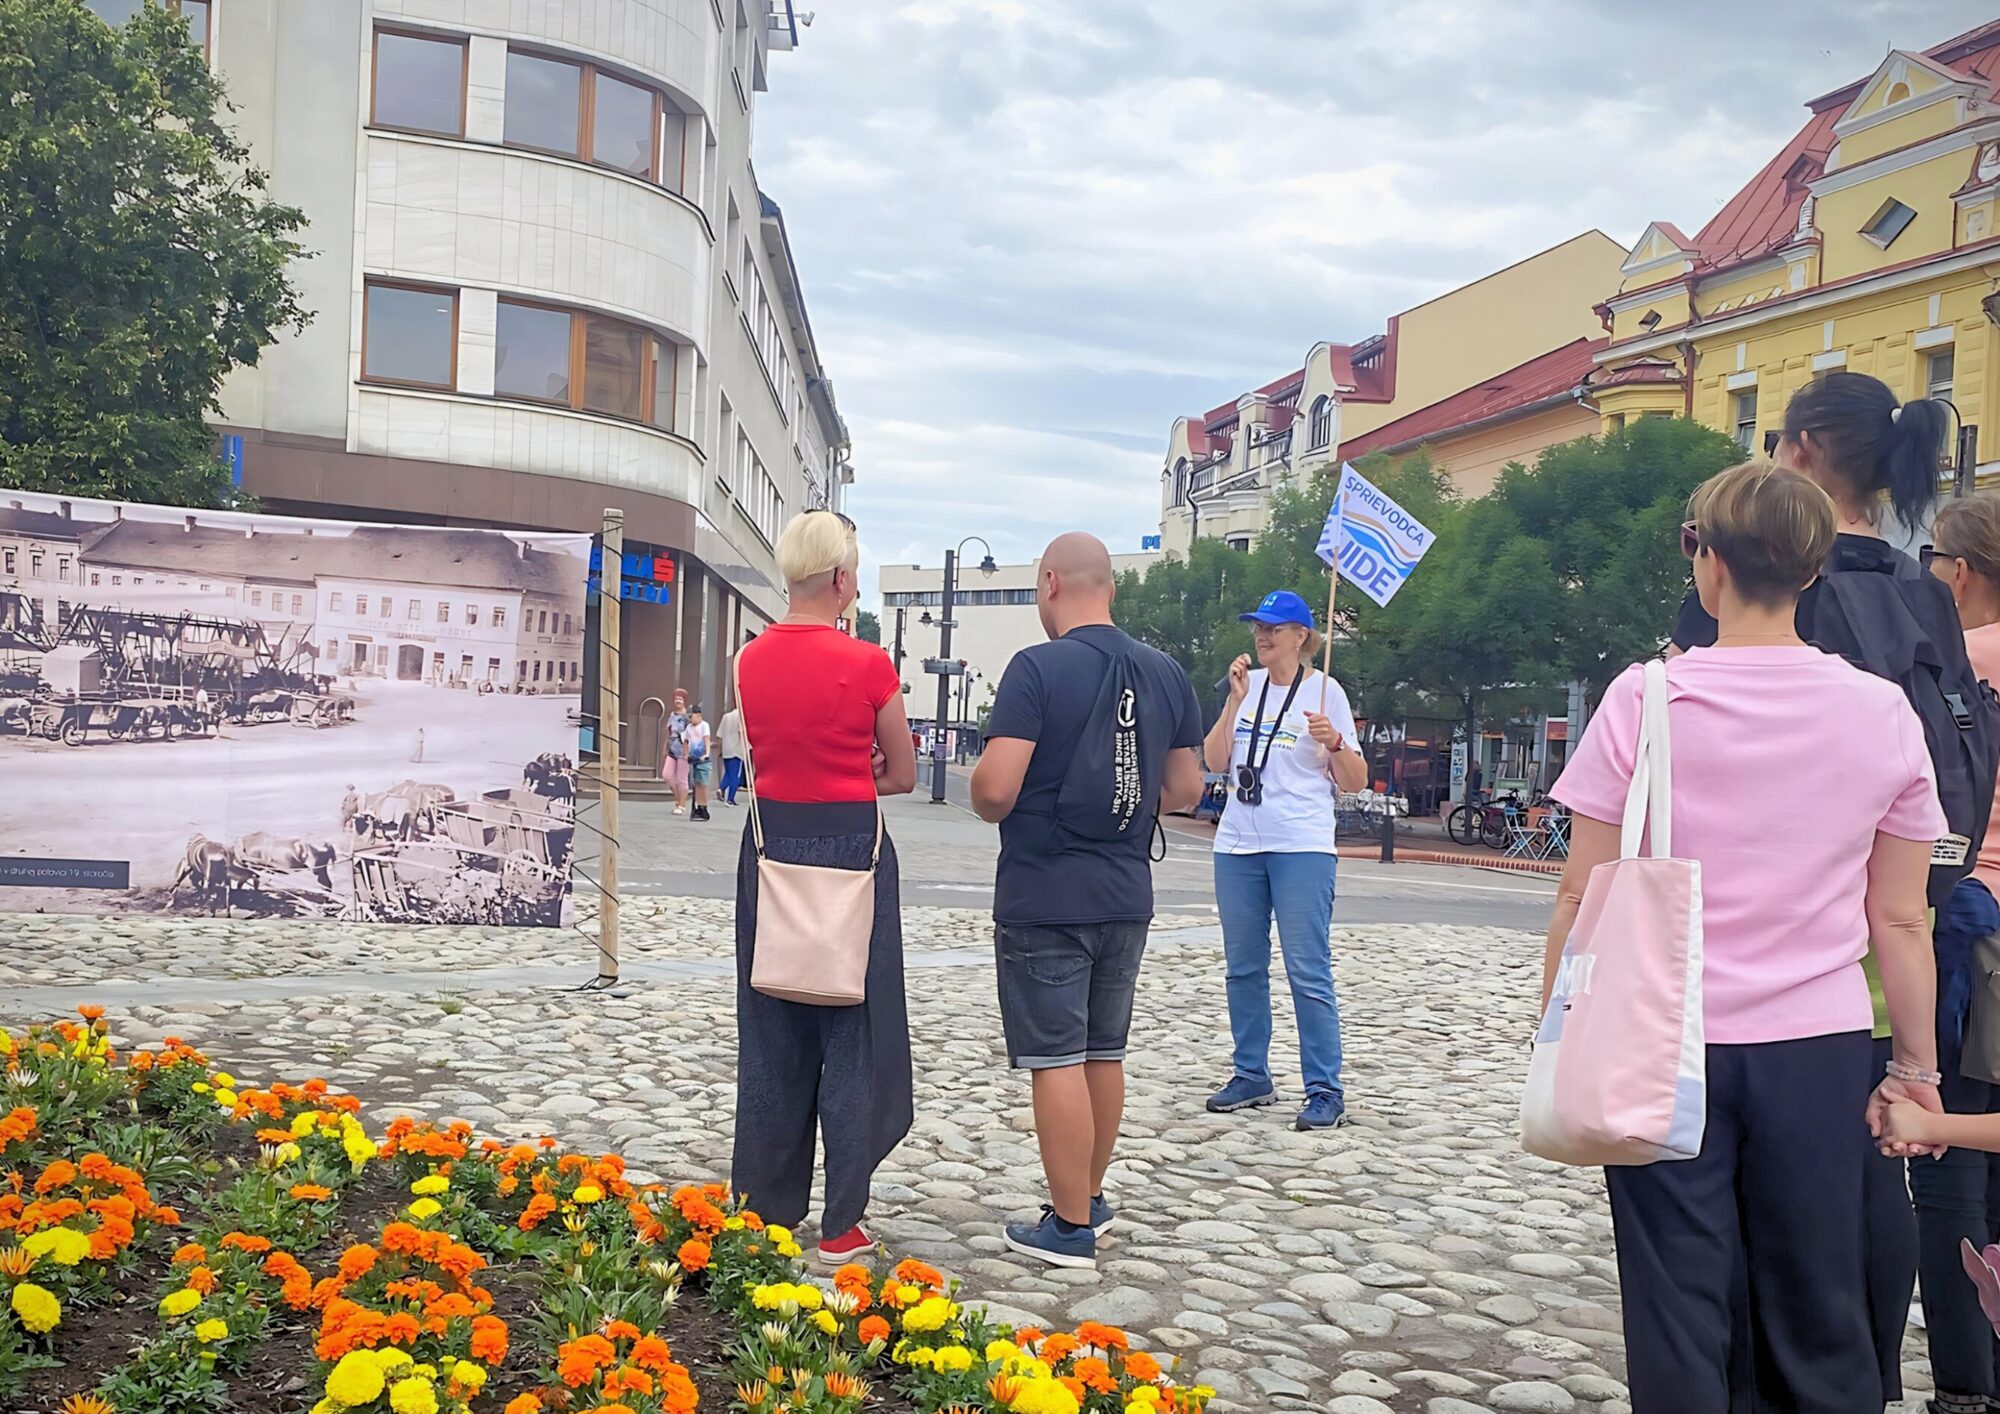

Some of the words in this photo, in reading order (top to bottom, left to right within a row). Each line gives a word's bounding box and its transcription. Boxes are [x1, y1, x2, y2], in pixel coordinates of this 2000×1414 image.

[1344, 476, 1425, 547] SPRIEVODCA
[1326, 540, 1397, 598] UIDE
[1115, 732, 1123, 764] SINCE
[1111, 765, 1123, 815] SIXTY-SIX
